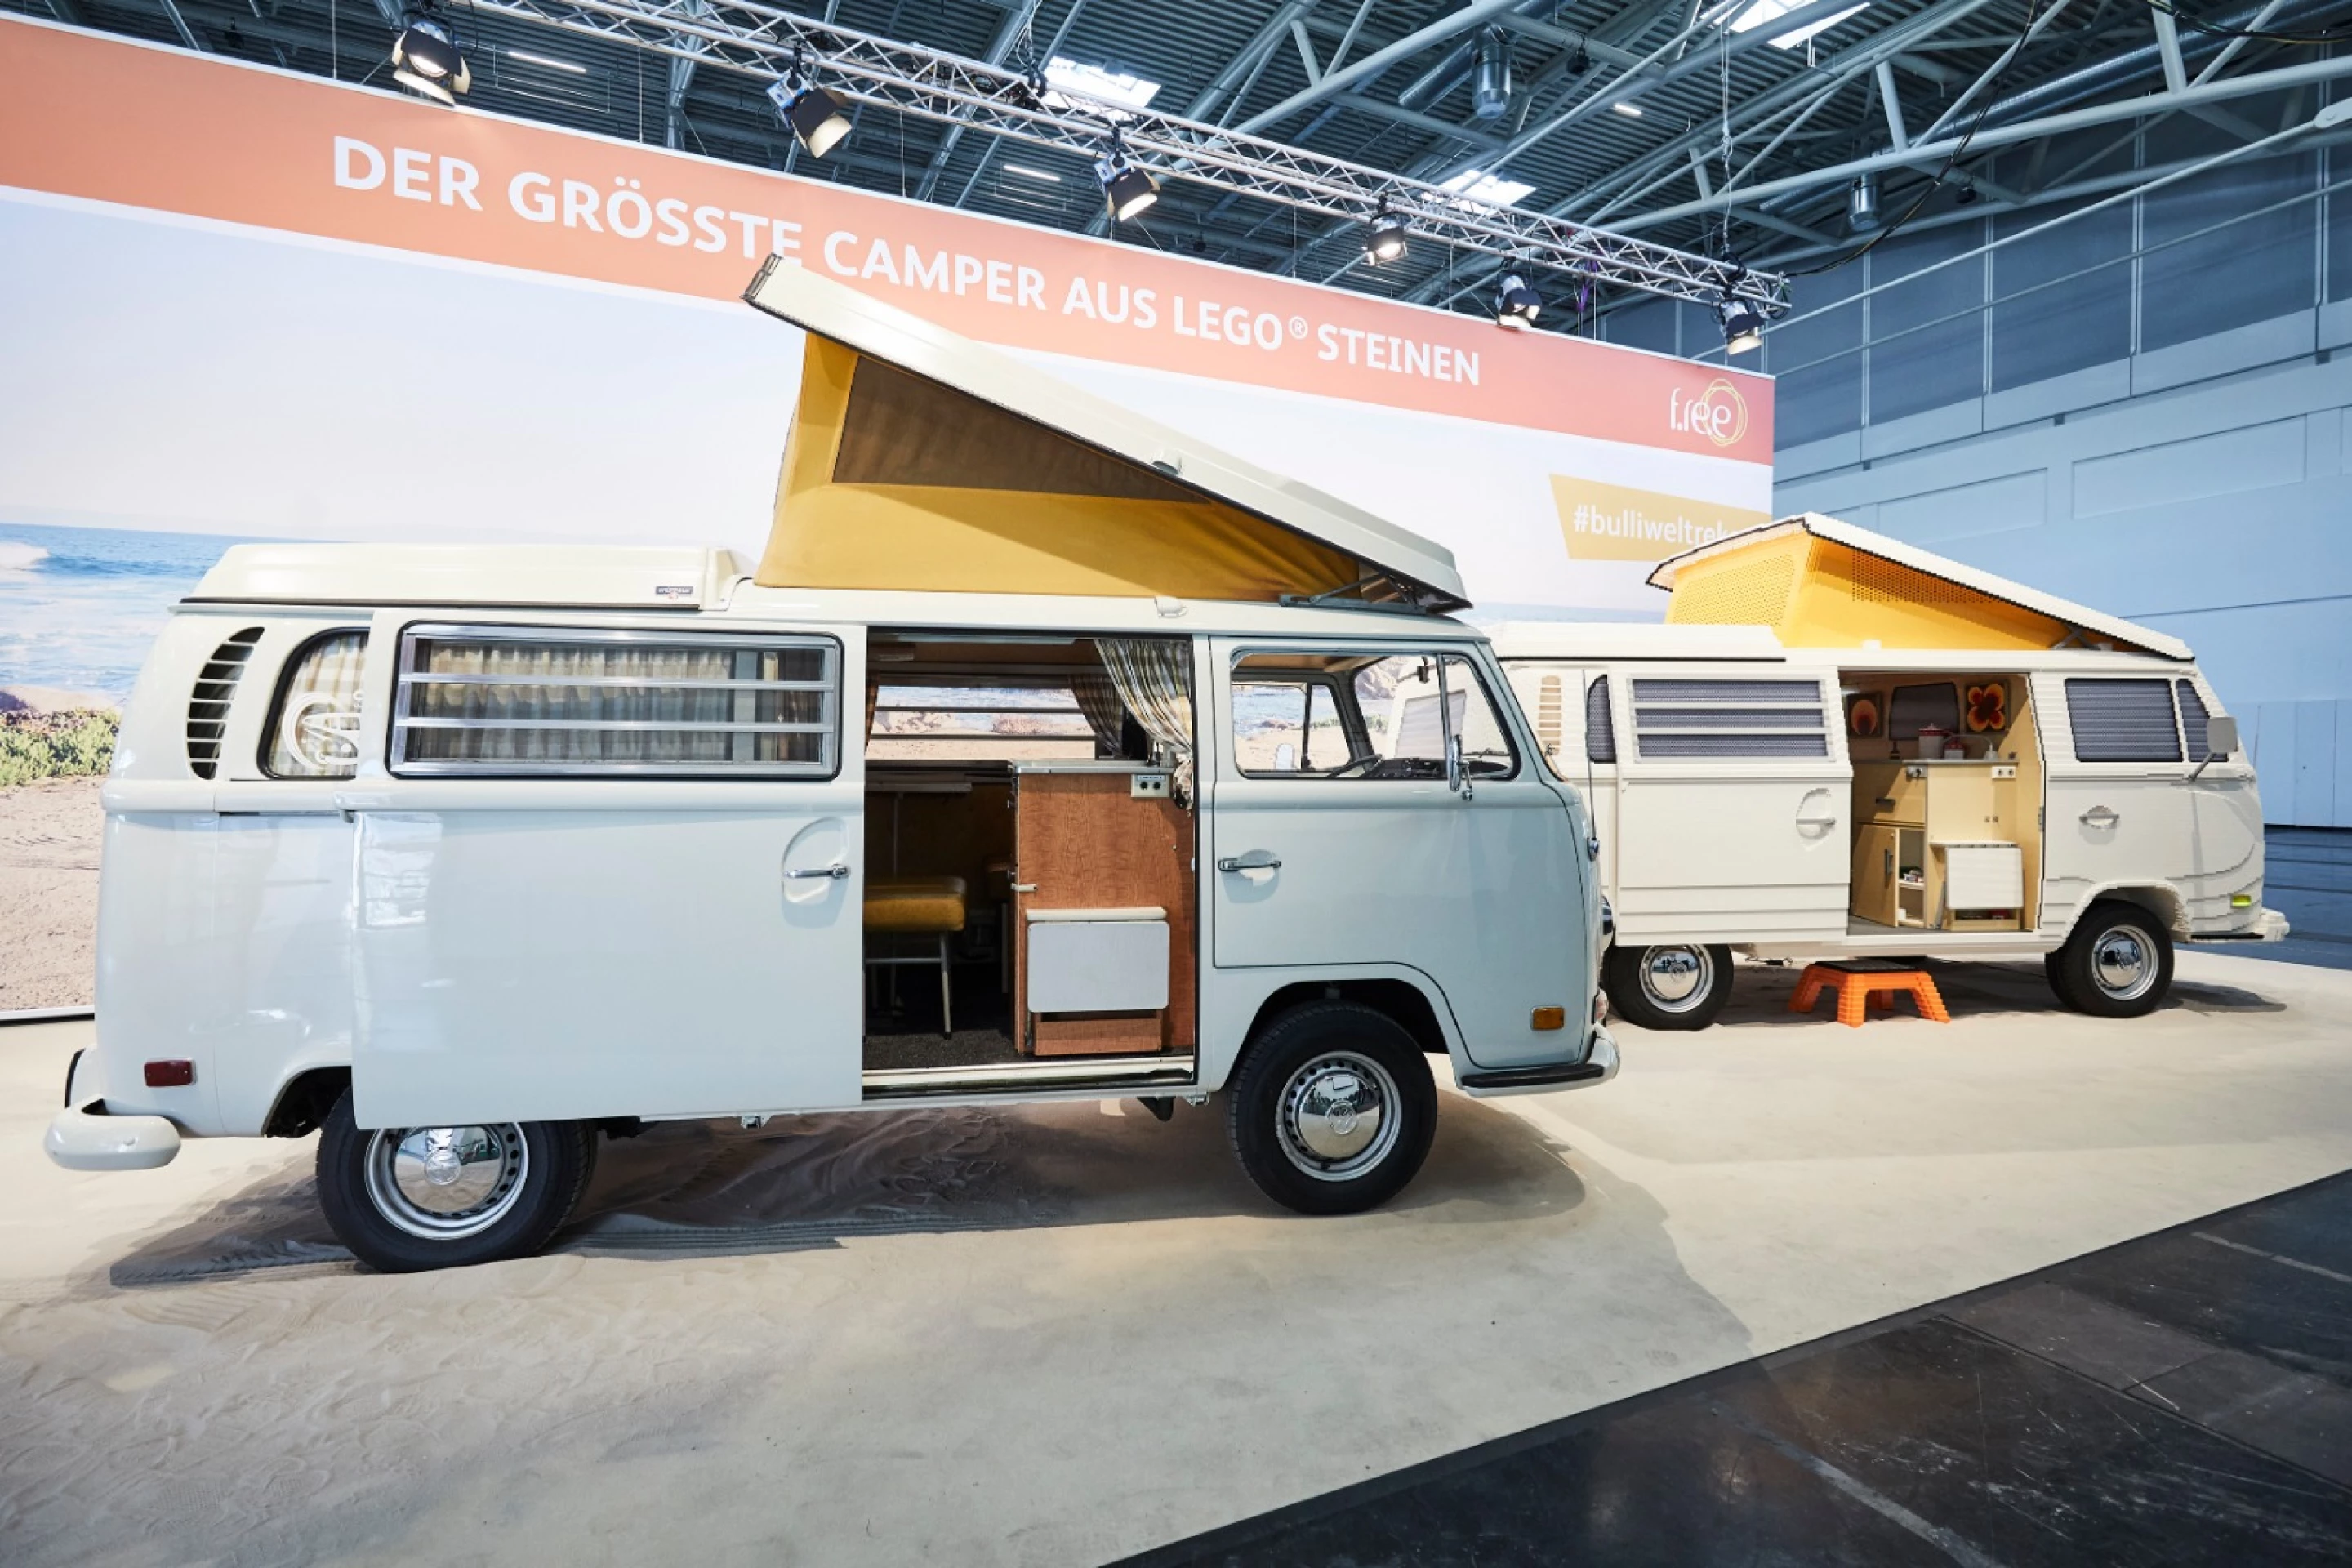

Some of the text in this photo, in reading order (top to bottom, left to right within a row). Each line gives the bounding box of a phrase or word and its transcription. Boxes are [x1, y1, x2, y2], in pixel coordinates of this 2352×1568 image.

[334, 135, 483, 211] DER
[508, 171, 803, 266] GRÖSSTE
[823, 230, 1046, 310] CAMPER
[1062, 275, 1158, 329] AUS
[1316, 323, 1480, 386] STEINEN
[1573, 503, 1733, 546] #bulliweltrek
